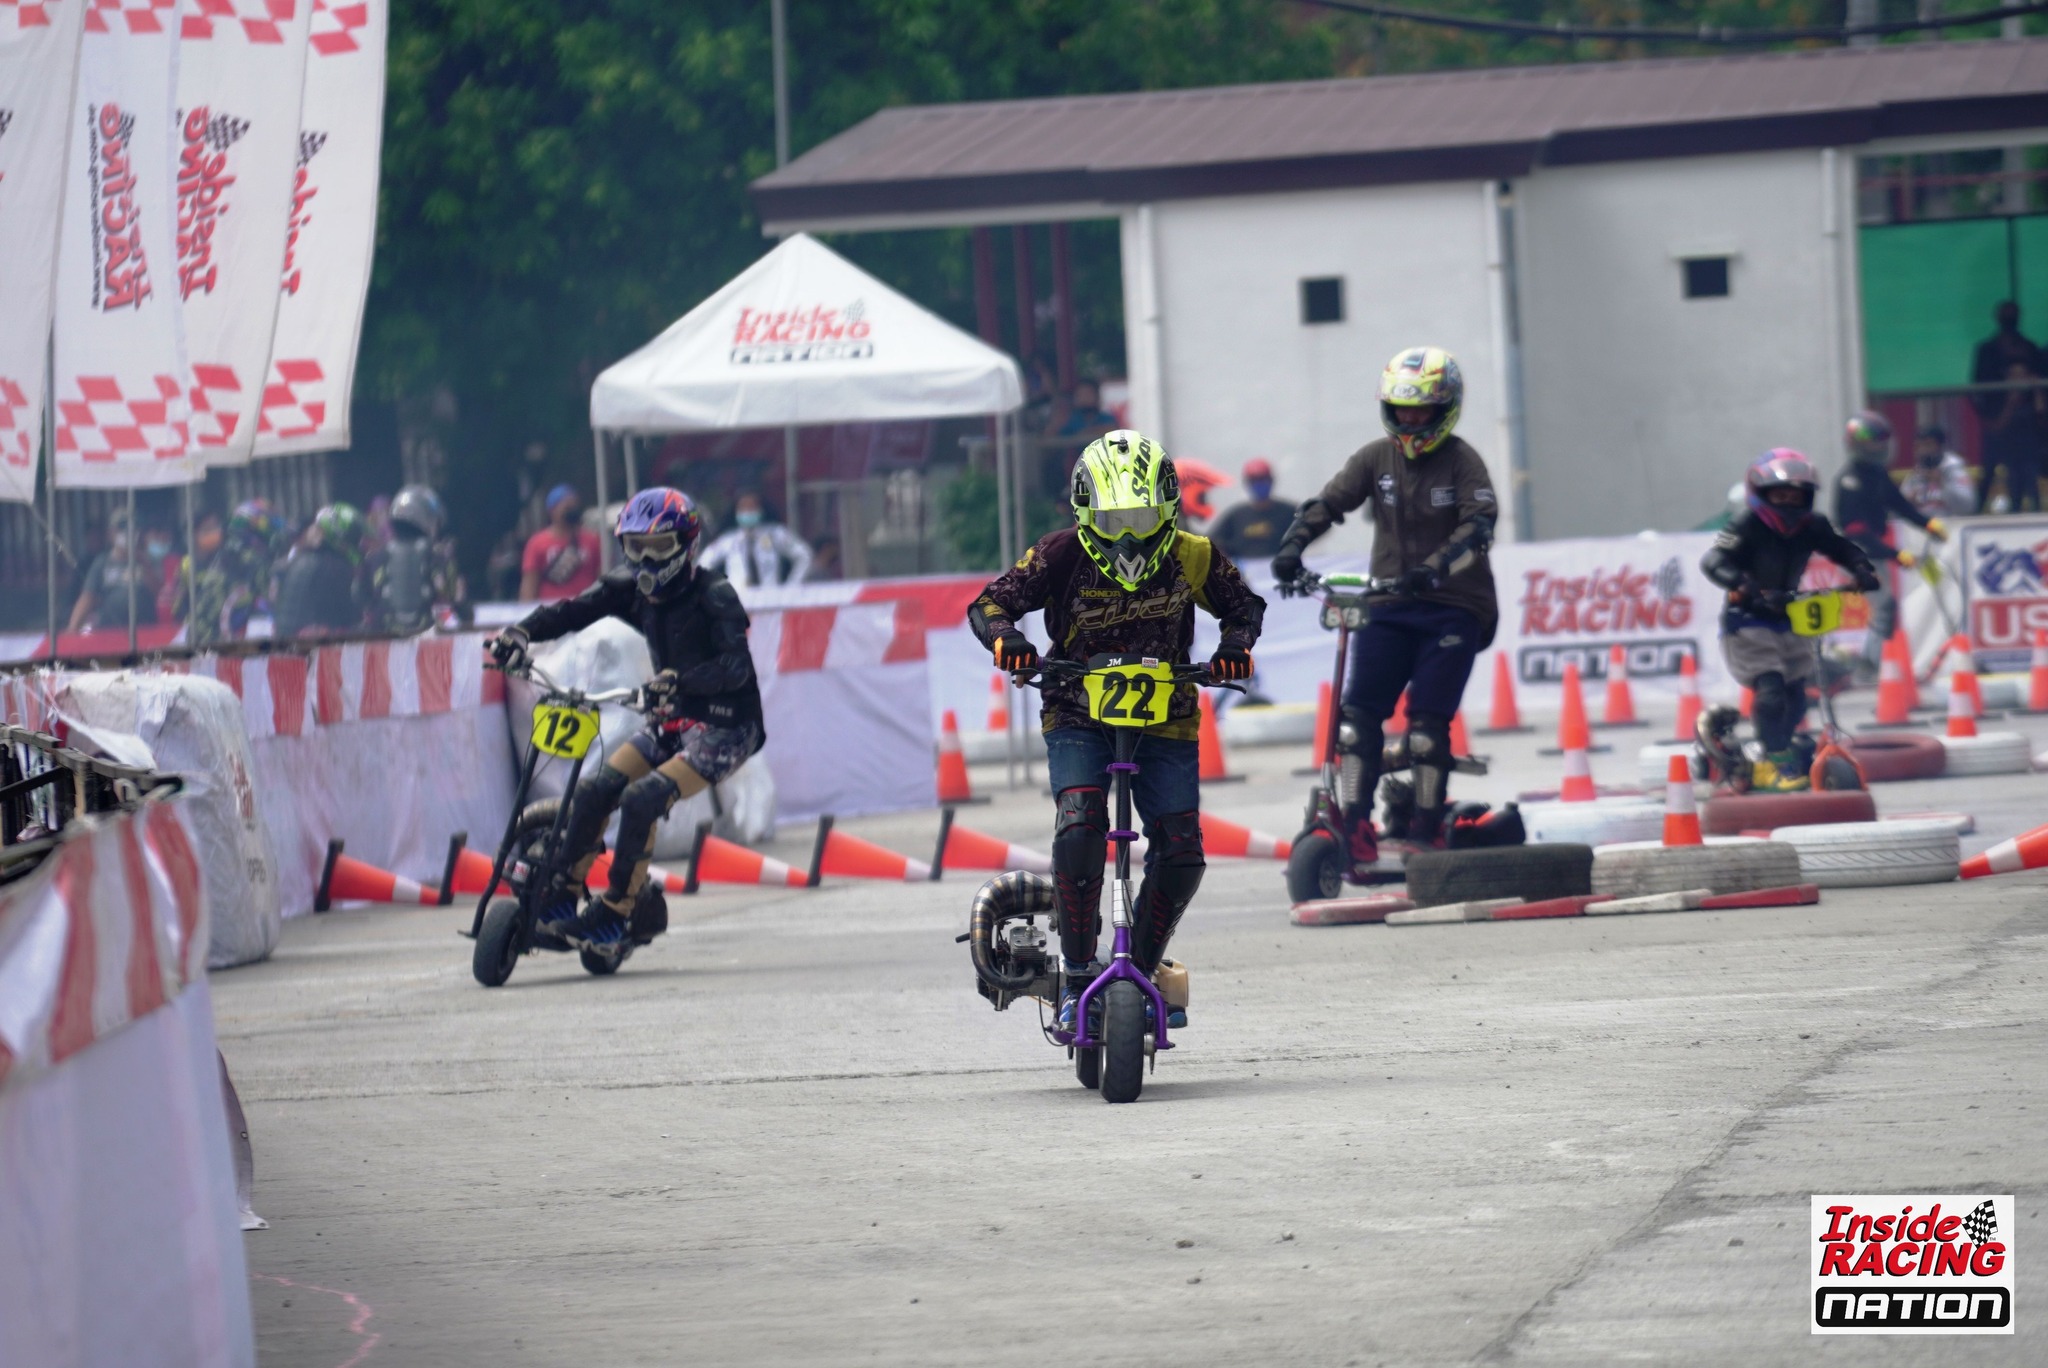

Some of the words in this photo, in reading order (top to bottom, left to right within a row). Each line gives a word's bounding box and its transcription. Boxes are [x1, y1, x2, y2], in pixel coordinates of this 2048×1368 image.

[1080, 589, 1122, 599] HONDA
[1519, 563, 1651, 604] Inside
[1519, 597, 1693, 636] RACING
[1806, 601, 1822, 630] 9
[1106, 657, 1122, 667] JM
[1522, 644, 1695, 678] NATON
[1102, 671, 1156, 721] 22
[544, 711, 580, 753] 12
